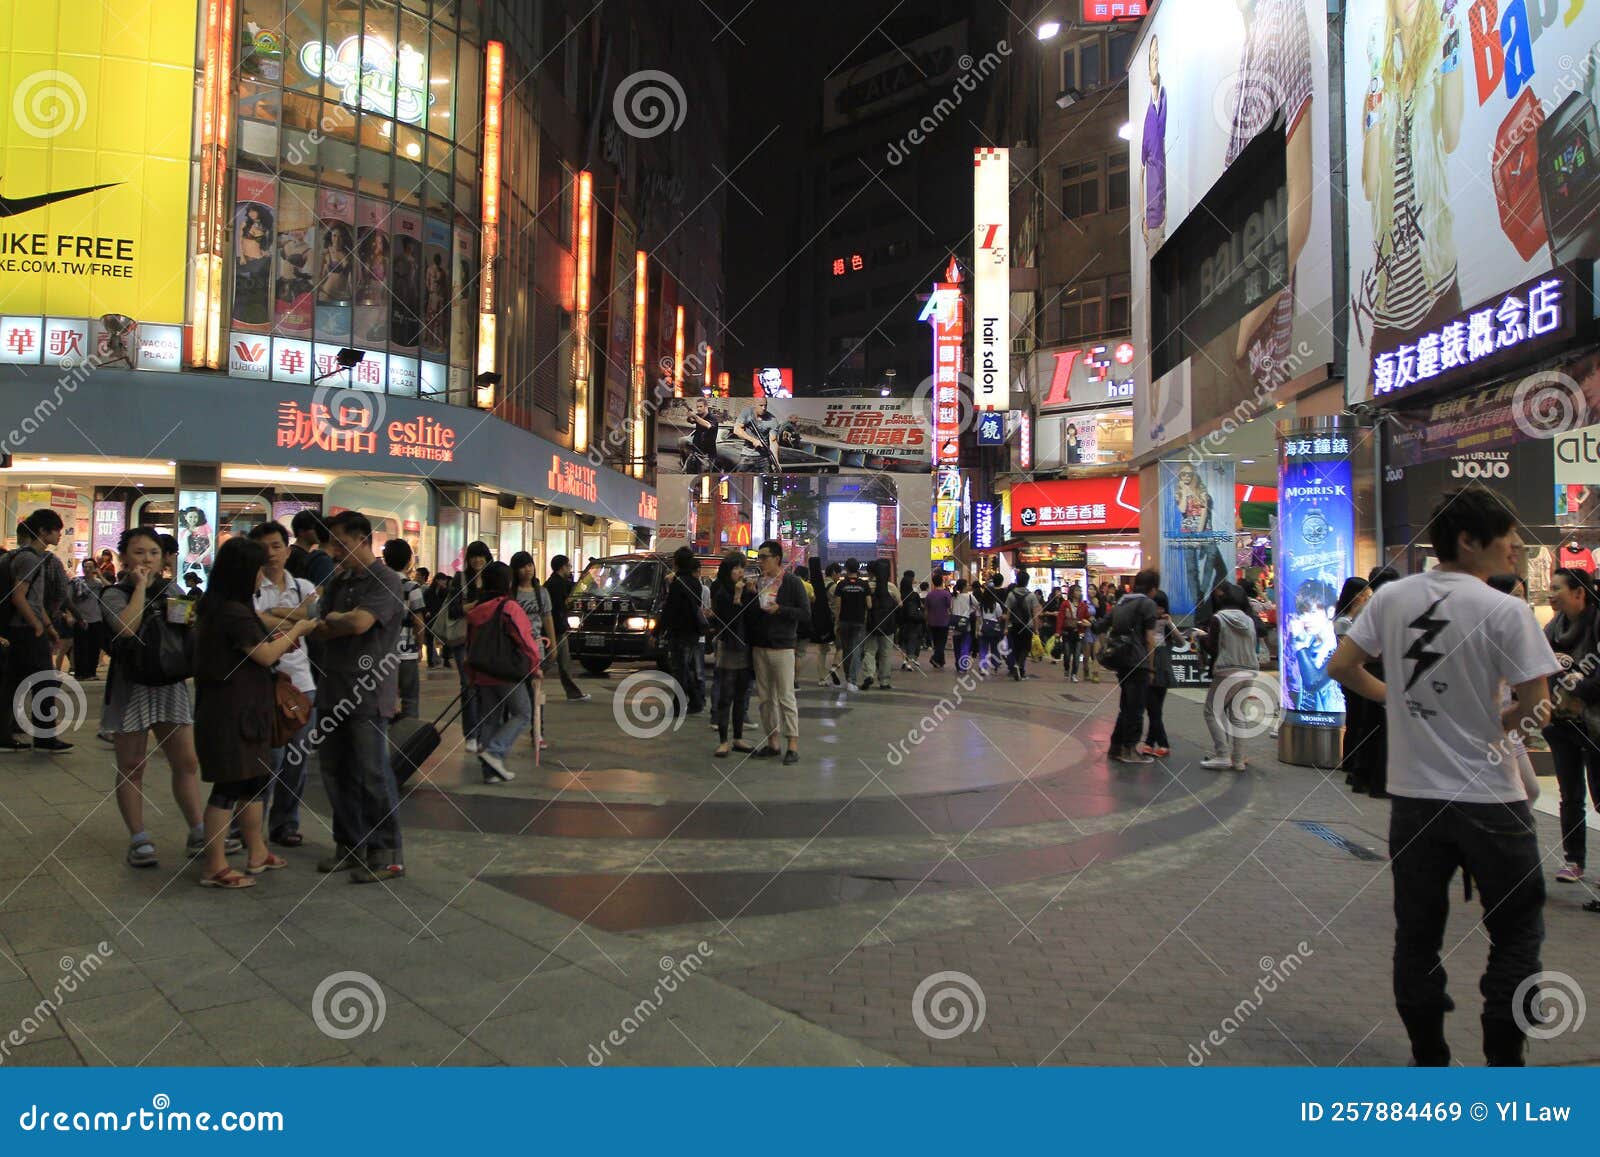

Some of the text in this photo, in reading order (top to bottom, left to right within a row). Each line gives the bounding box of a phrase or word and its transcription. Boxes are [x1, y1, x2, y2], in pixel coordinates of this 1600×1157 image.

[1095, 2, 1141, 16] 西門店
[57, 235, 134, 261] FREE
[983, 317, 999, 395] hair salon
[276, 400, 377, 454] 誠品
[388, 415, 455, 448] eslite
[1284, 438, 1349, 457] 海友鐘錶
[1451, 451, 1510, 460] ATURALLY
[1451, 461, 1511, 479] JOJO
[1286, 485, 1347, 498] MORRIS K
